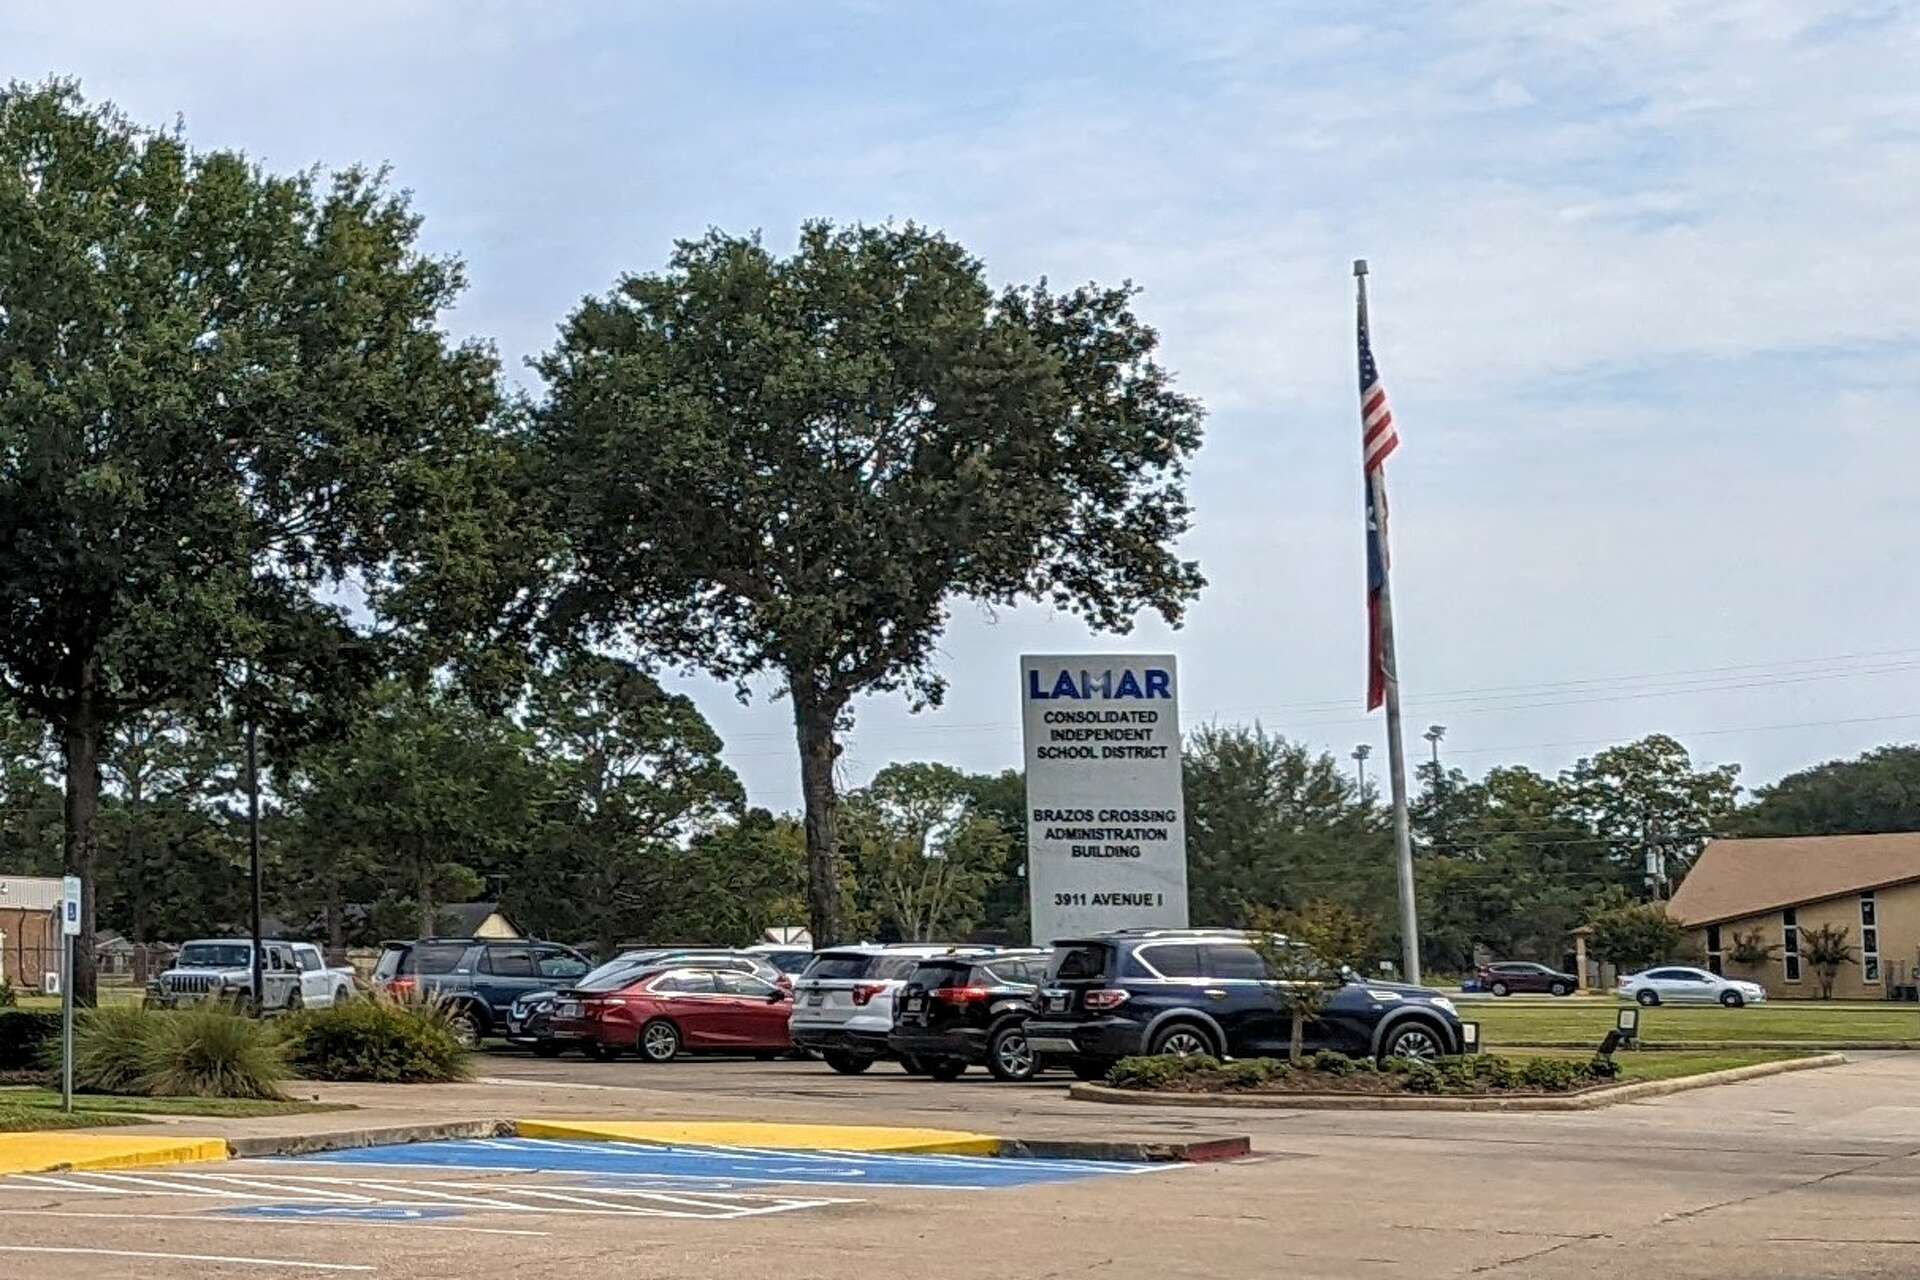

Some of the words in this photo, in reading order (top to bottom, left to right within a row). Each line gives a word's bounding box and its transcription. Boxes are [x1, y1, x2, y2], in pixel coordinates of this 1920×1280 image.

[1030, 670, 1171, 699] LAMAR
[1044, 711, 1158, 724] CONSOLIDATED
[1050, 729, 1153, 741] INDEPENDENT
[1037, 746, 1098, 759] SCHOOL
[1102, 746, 1168, 758] DISTRICT
[1034, 810, 1094, 822] BRAZOS
[1098, 810, 1176, 822] CROSSING
[1045, 828, 1167, 840] ADMINISTRATION
[1072, 846, 1140, 857] BUILDING
[1055, 894, 1087, 906] 3911
[1091, 894, 1153, 906] AVENUE
[1158, 894, 1163, 906] I
